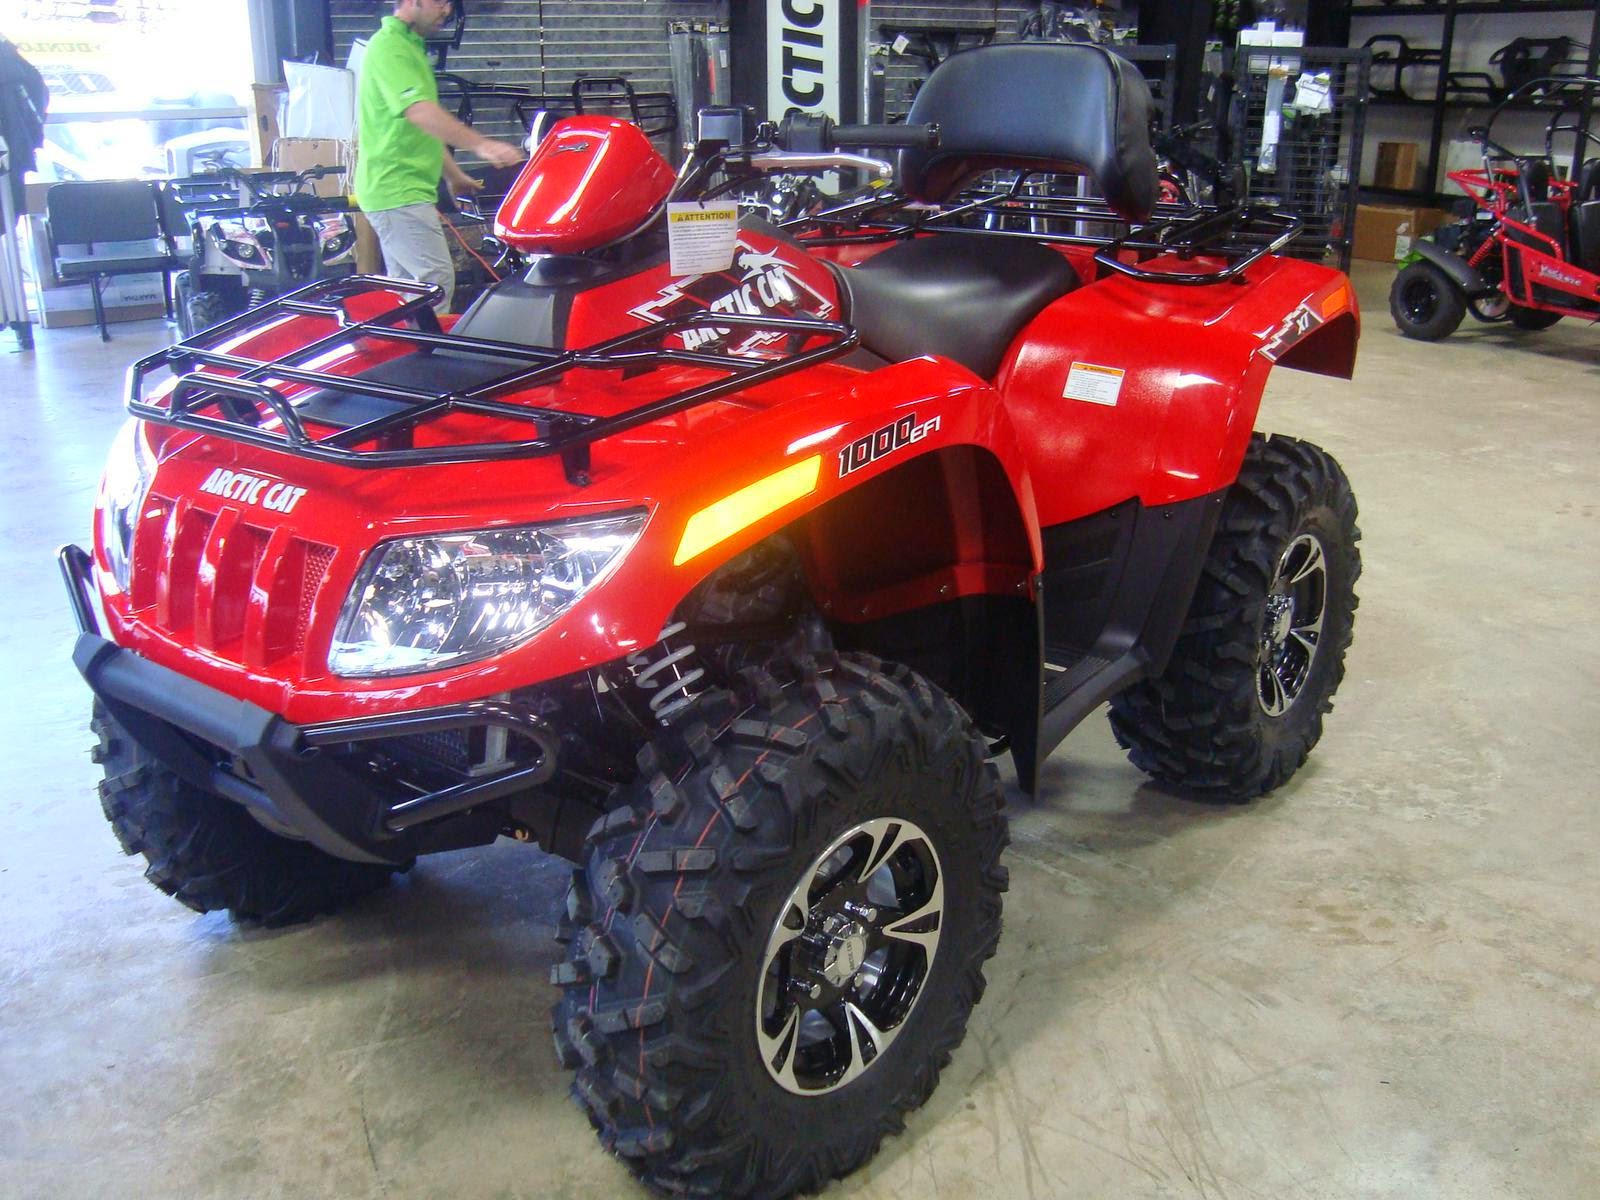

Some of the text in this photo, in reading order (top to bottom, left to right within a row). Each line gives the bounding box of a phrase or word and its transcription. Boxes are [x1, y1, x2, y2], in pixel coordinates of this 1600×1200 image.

[781, 0, 825, 122] CTIC
[684, 212, 731, 221] ATTENTION
[838, 411, 941, 479] 1000 EFI
[199, 467, 309, 514] ARCTIC CAT
